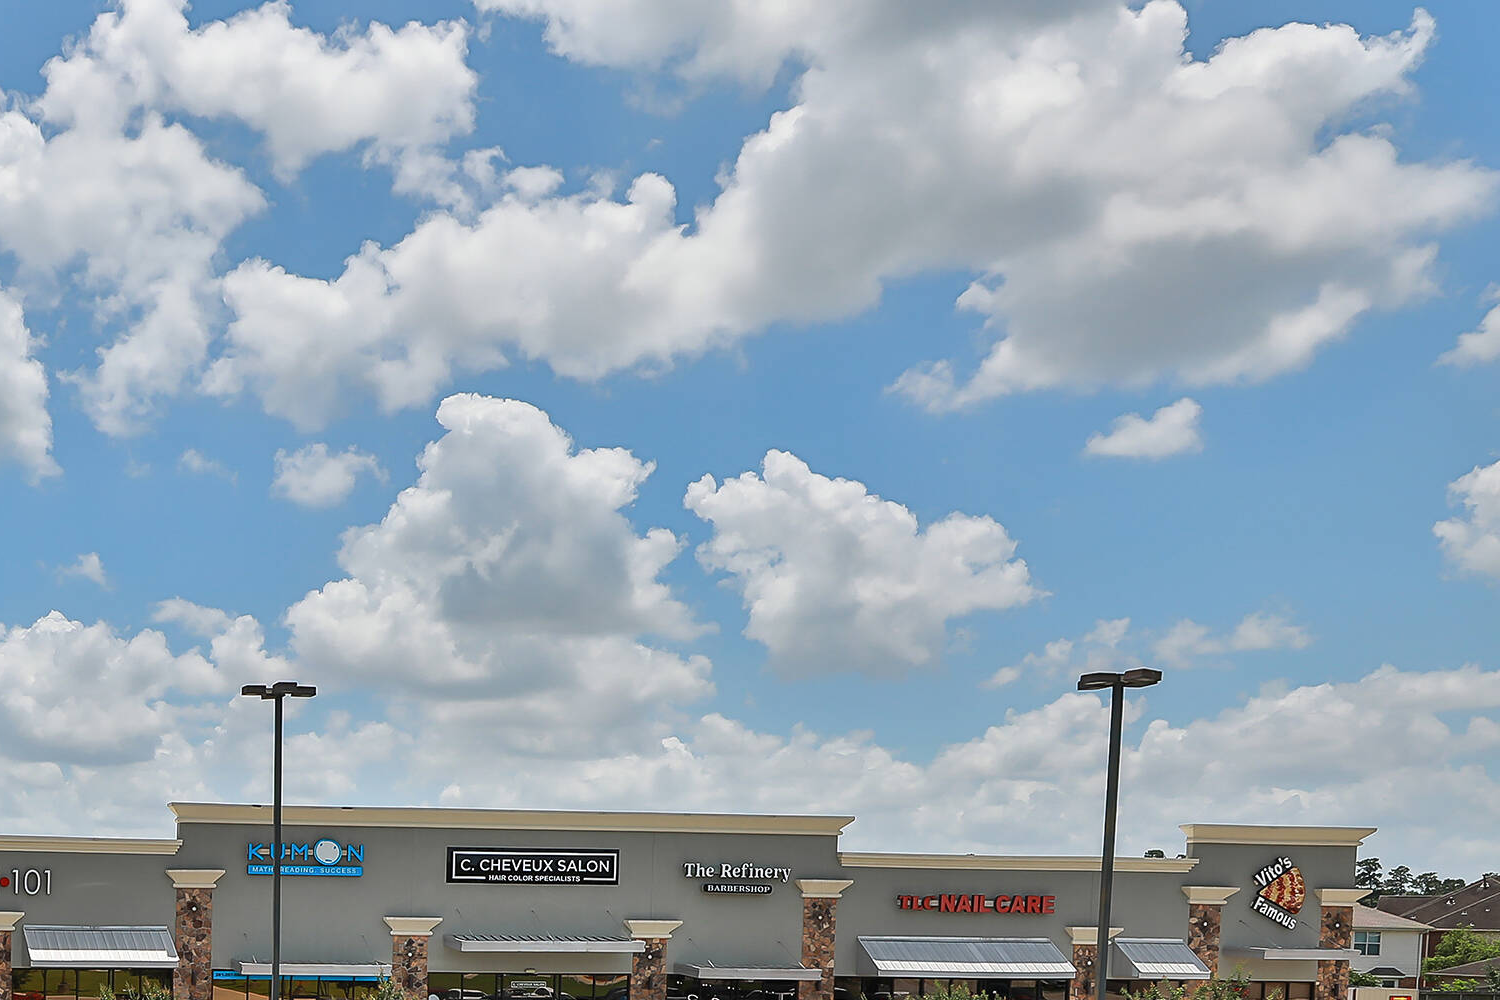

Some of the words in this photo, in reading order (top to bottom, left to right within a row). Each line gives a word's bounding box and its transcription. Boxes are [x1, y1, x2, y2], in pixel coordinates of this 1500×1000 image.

[248, 838, 364, 866] KUMON
[460, 859, 475, 871] C.
[479, 859, 553, 872] CHEVEUX
[557, 860, 610, 873] SALON
[684, 863, 715, 878] The
[720, 862, 791, 883] Refinery
[1254, 856, 1293, 887] Vito's
[12, 869, 51, 895] 101
[534, 875, 581, 883] SPECIALISTS
[707, 884, 771, 893] BARBERSHOP
[898, 895, 936, 911] TLC
[939, 894, 992, 913] NAIL
[995, 895, 1056, 914] CARE
[1253, 896, 1297, 930] Famous
